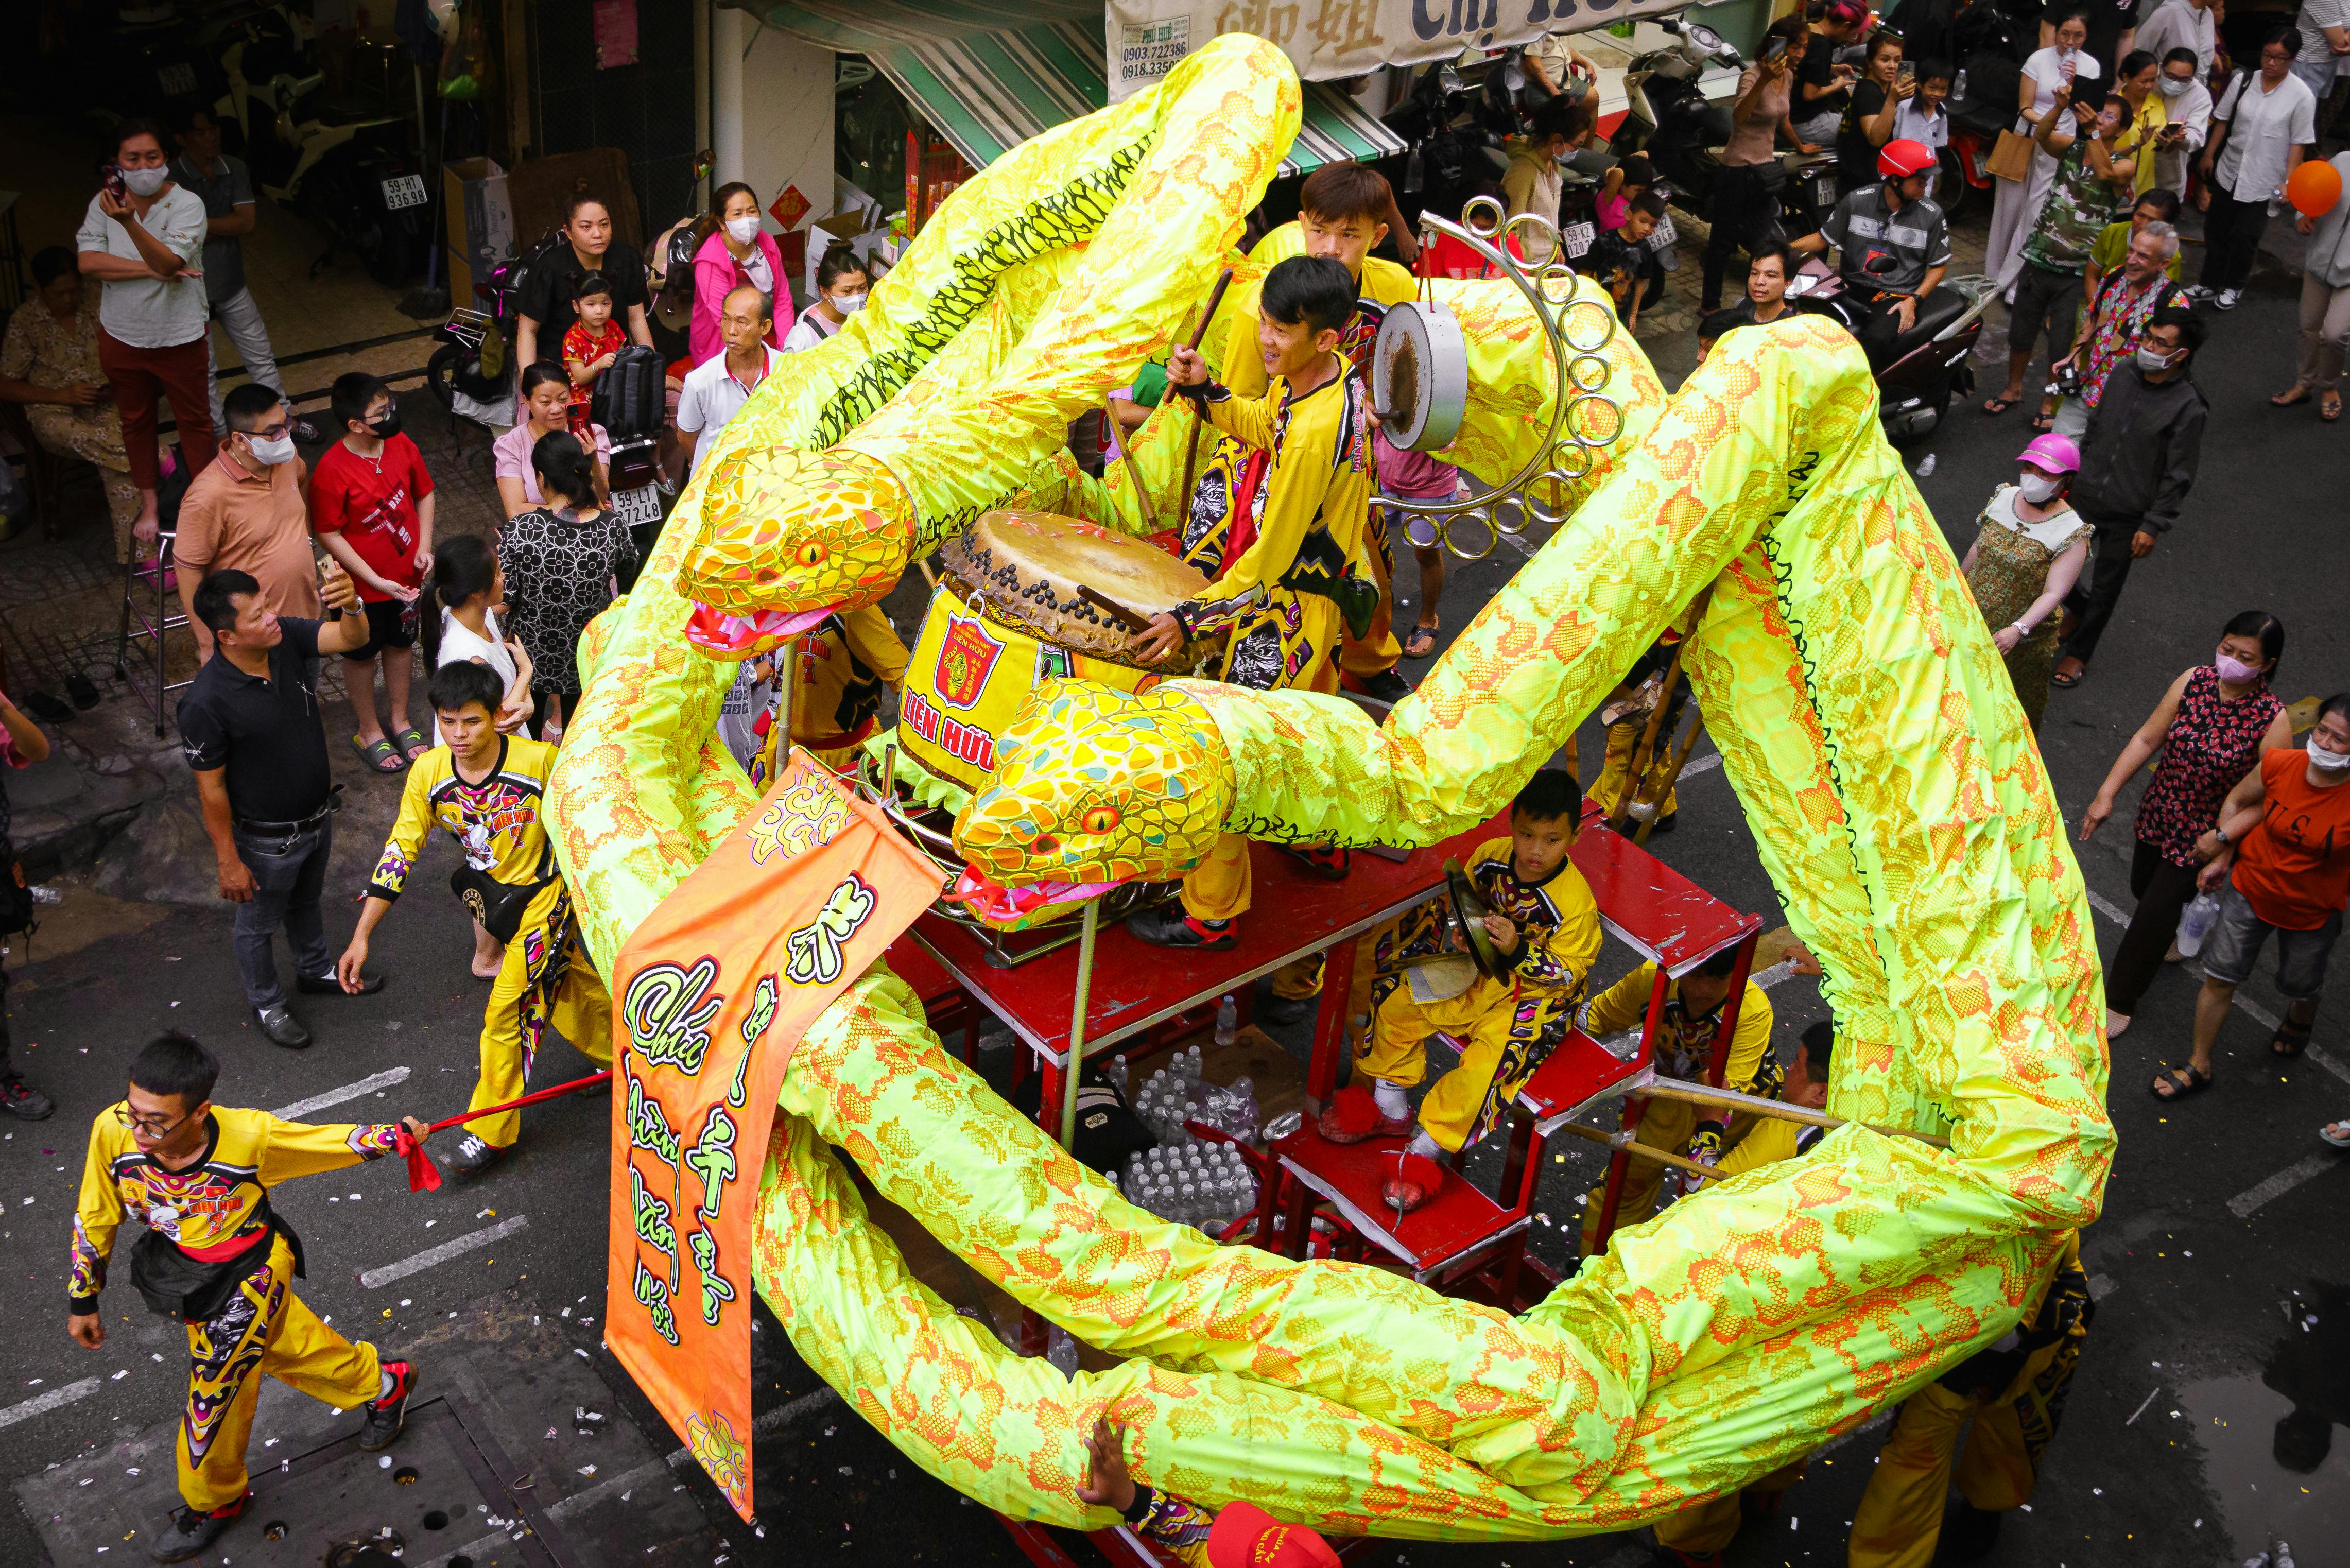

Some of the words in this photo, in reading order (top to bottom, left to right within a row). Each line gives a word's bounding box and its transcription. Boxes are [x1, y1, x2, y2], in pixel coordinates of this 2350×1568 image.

[1123, 41, 1186, 62] 0903.722386
[1122, 59, 1180, 79] 0918.3350
[388, 177, 417, 193] 59-H1
[779, 192, 800, 216] 福
[1567, 226, 1591, 243] 59-K2
[617, 487, 651, 508] 59-L1
[953, 632, 967, 647] LIÊN
[903, 687, 940, 743] LIÊN
[941, 716, 995, 772] HỮU
[624, 962, 722, 1075] Chúc
